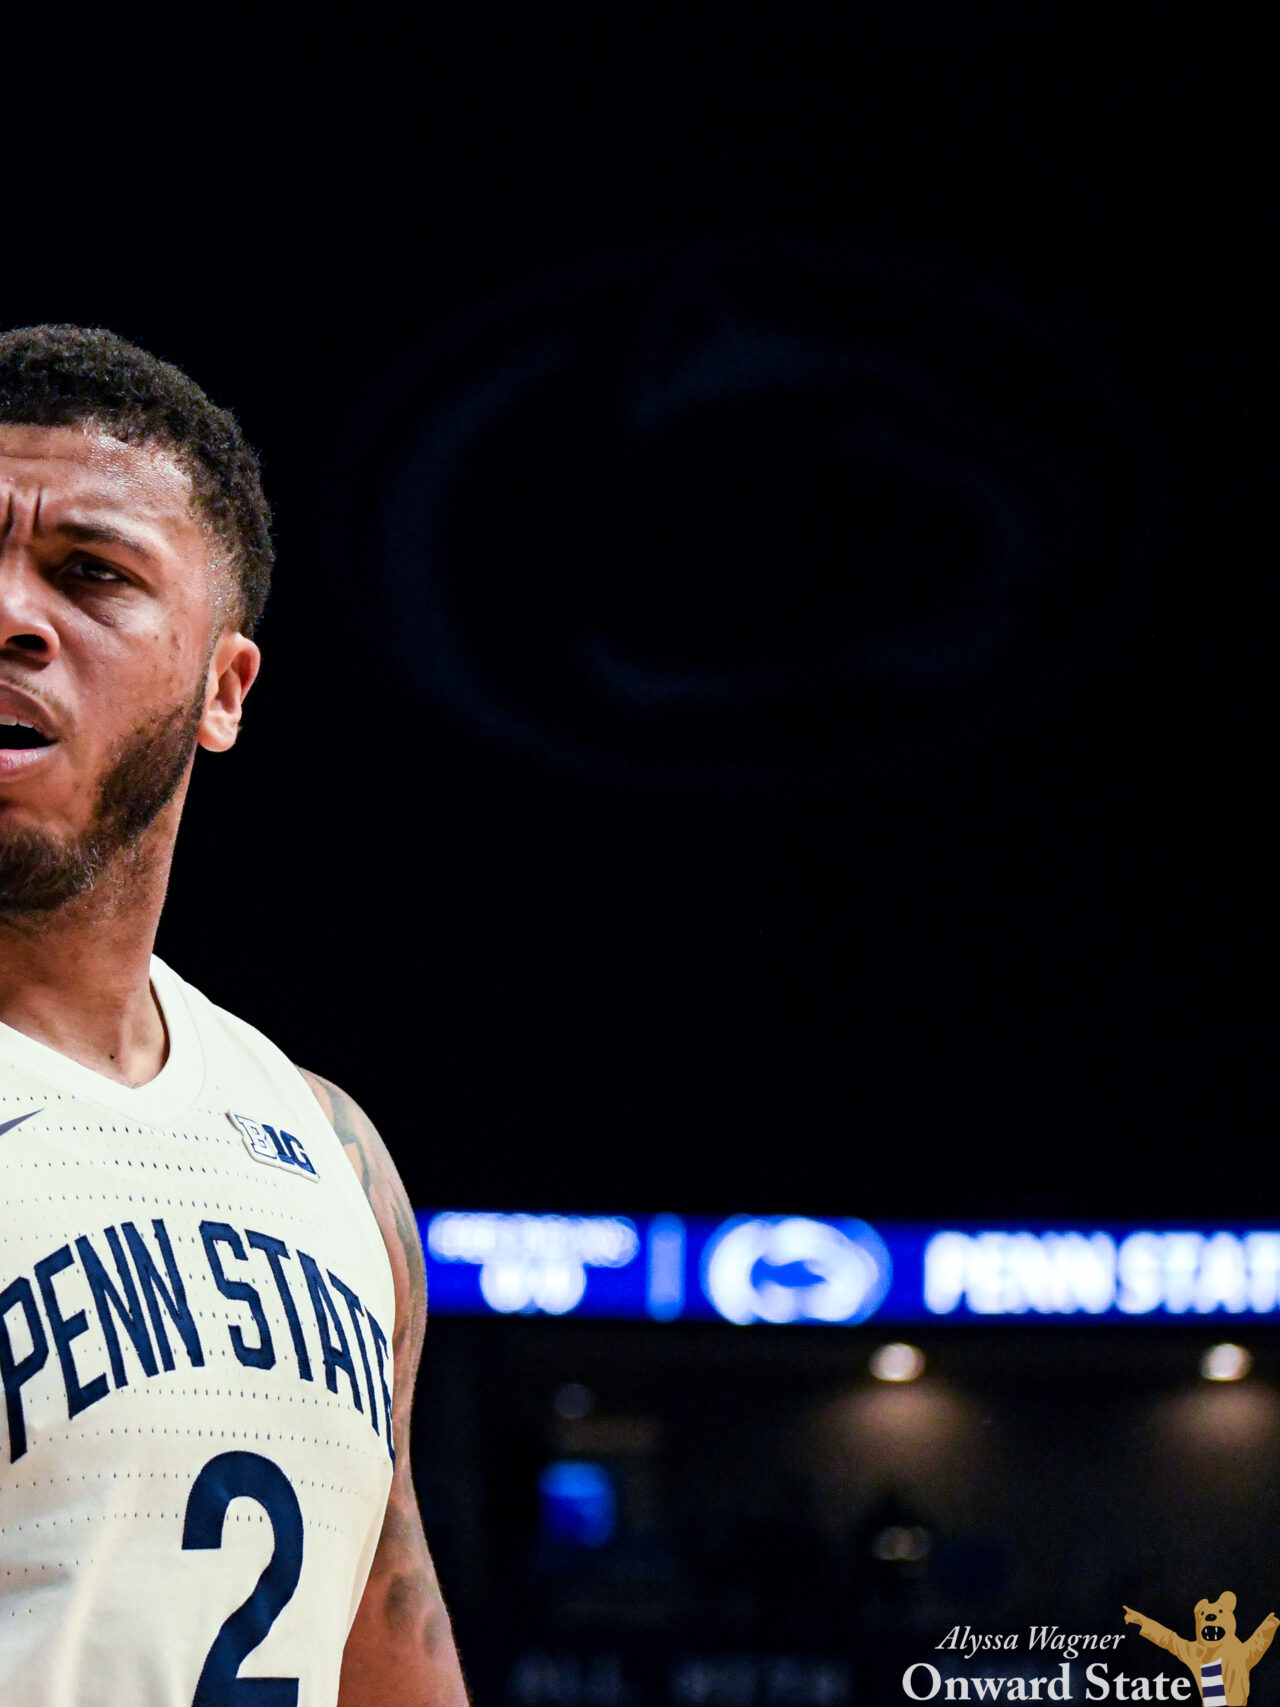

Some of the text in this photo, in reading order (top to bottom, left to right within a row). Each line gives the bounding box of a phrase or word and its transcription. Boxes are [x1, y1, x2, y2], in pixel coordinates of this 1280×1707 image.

[923, 1230, 1280, 1315] PENN STAT
[182, 1450, 305, 1707] 2
